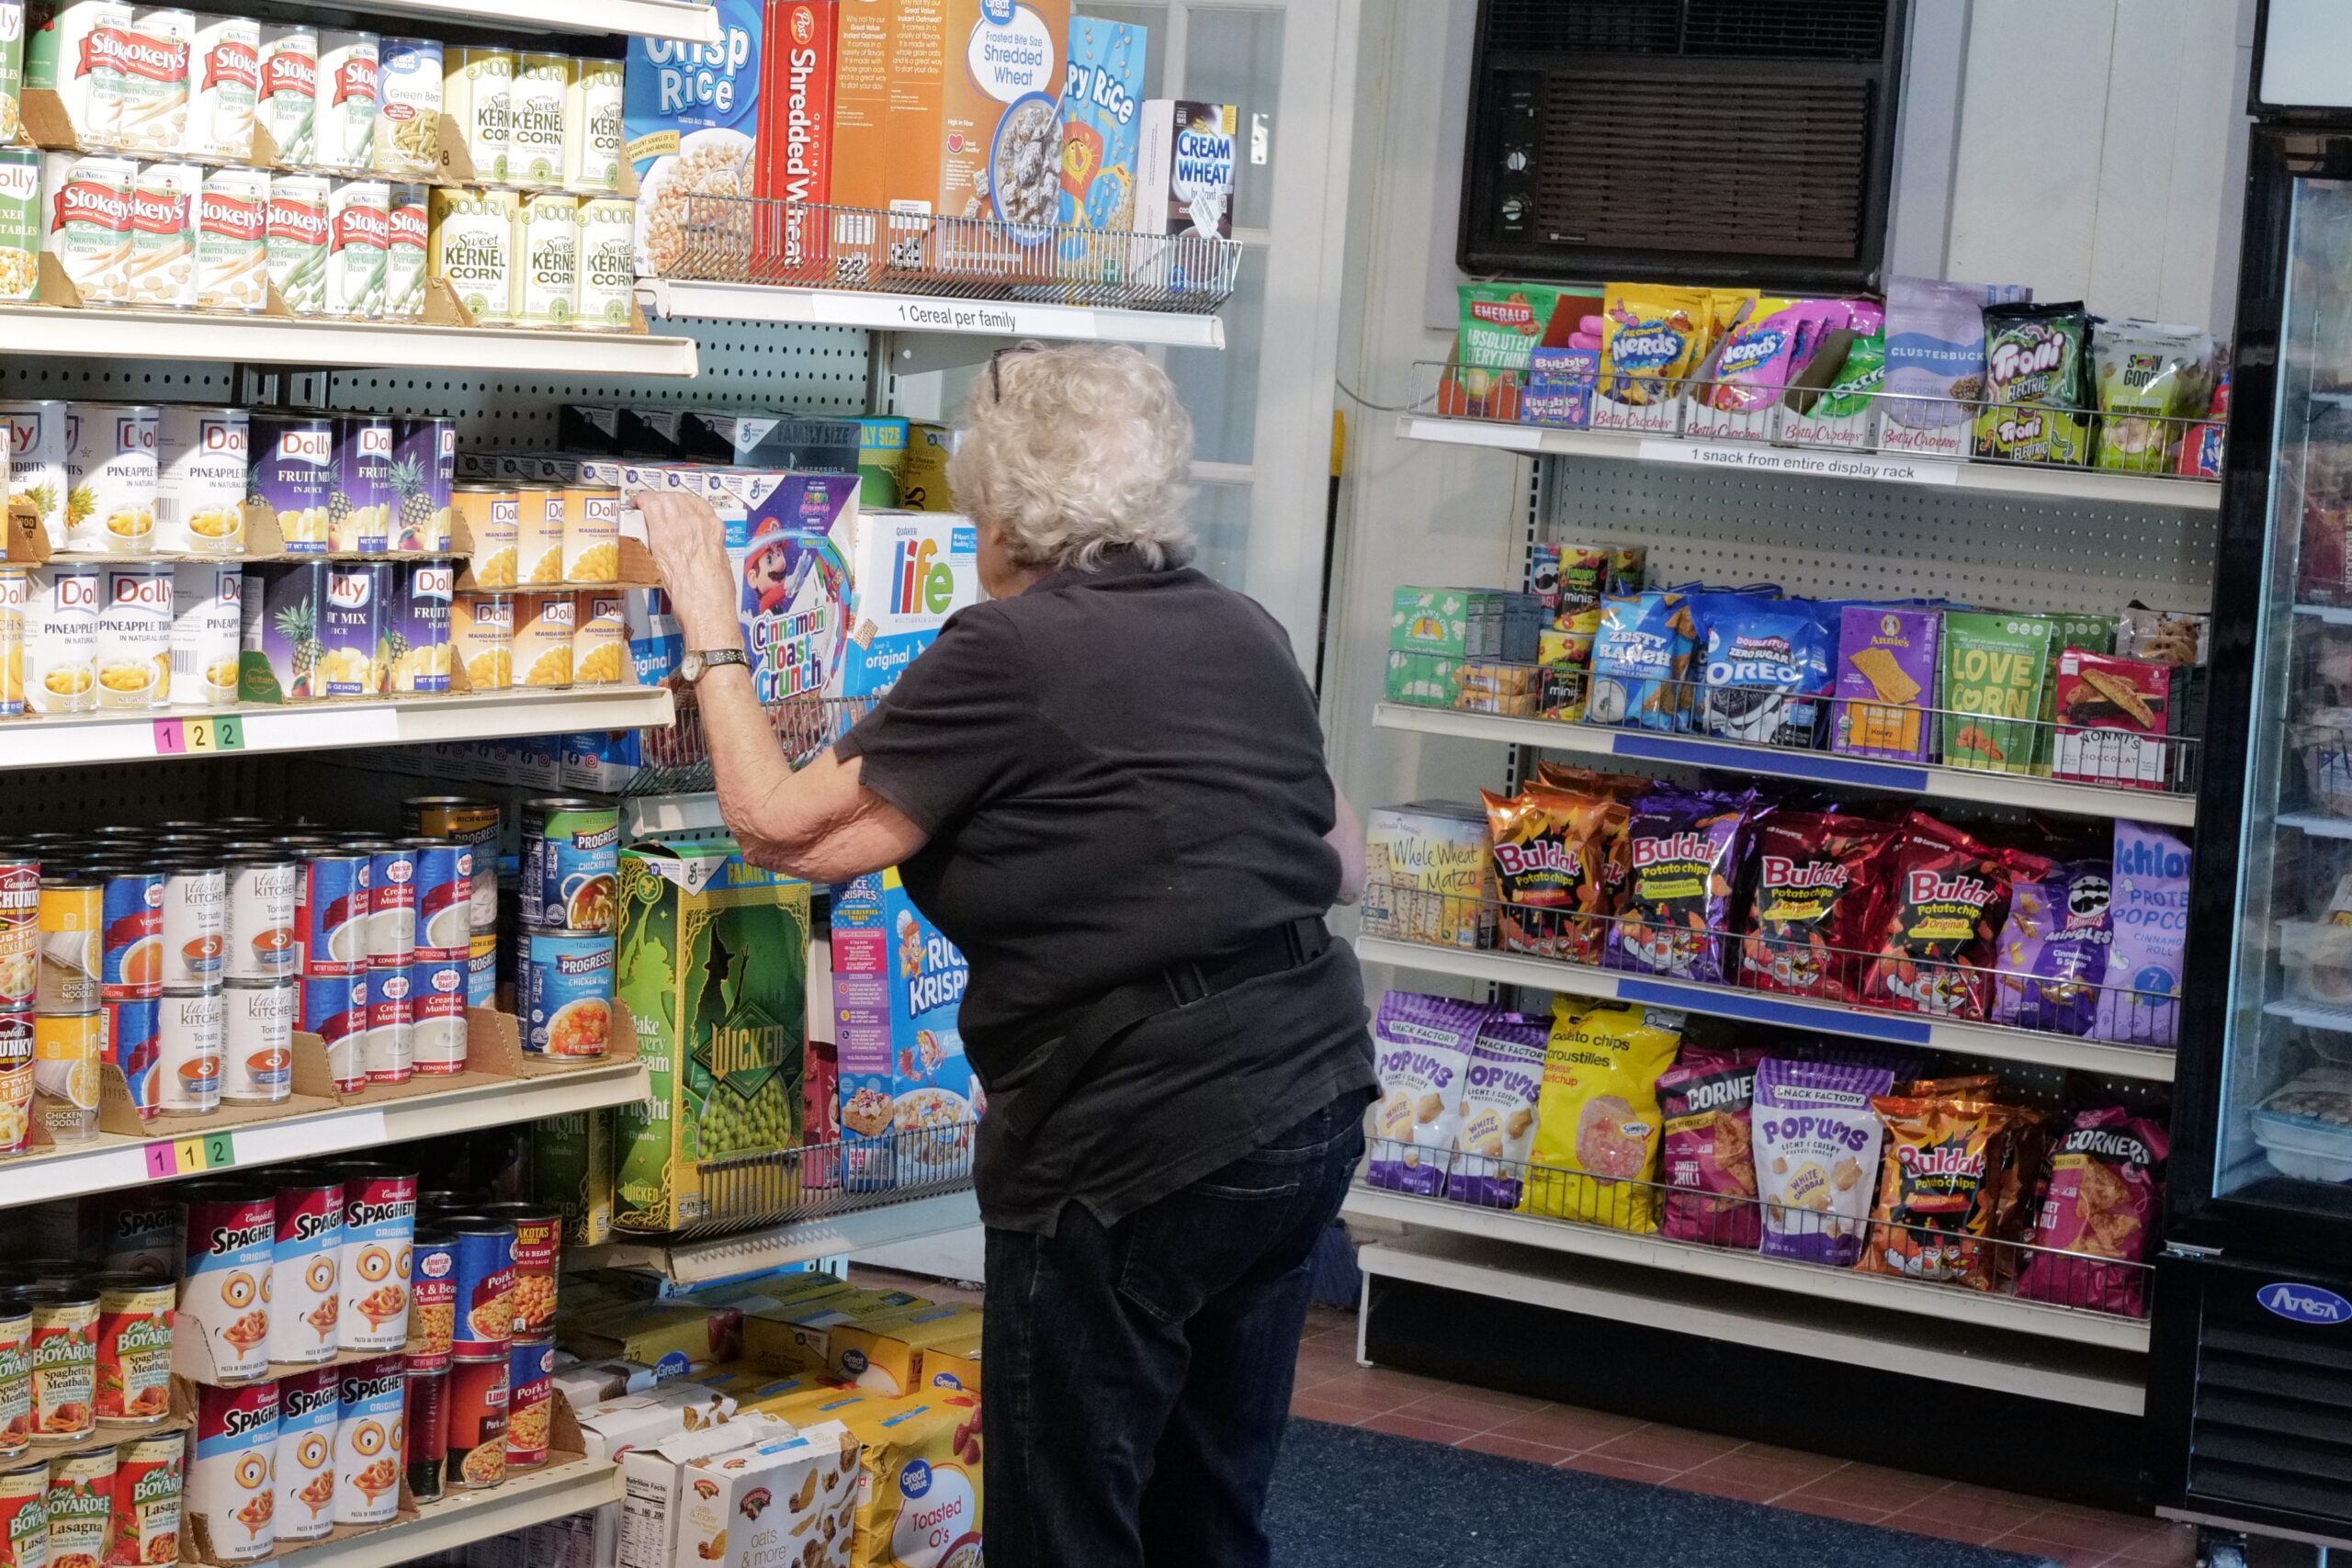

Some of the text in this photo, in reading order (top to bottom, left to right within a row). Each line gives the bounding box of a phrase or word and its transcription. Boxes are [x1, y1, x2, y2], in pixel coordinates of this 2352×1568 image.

[793, 12, 813, 39] Post
[986, 31, 1043, 47] Frosted Bite Size
[387, 51, 415, 63] Great
[984, 45, 1043, 66] Shredded
[994, 66, 1033, 87] Wheat
[660, 66, 736, 112] Rice
[1091, 64, 1135, 126] Rice
[786, 49, 817, 175] Shredded
[512, 113, 564, 132] KERNEL
[517, 132, 562, 145] CORN
[1178, 131, 1230, 160] CREAM
[442, 151, 449, 166] 8
[811, 113, 820, 187] ORIGINAL
[1178, 160, 1230, 186] WHEAT
[457, 233, 498, 250] Sweet
[446, 248, 506, 267] KERNEL
[591, 254, 632, 274] KERNEL
[450, 267, 503, 280] CORN
[595, 274, 632, 287] CORN
[899, 305, 1015, 332] 1 Cereal per family
[1475, 305, 1530, 322] EMERALD
[1467, 329, 1537, 352] ABSOLUTELY
[1534, 357, 1590, 368] Bubble
[1992, 332, 2067, 386] Trolli
[2007, 375, 2050, 403] ELECTRIC
[1525, 397, 1578, 407] Bubble
[1595, 411, 1671, 430] Betty Crocker
[1997, 416, 2043, 443] Trolli
[778, 425, 849, 445] FAMILY SIZE
[879, 426, 900, 446] SIZE
[283, 432, 331, 457] Dolly
[107, 467, 154, 478] PINEAPPLE
[190, 467, 239, 478] PINEAPPLE
[1691, 448, 1915, 479] 1 snack from entire display rack
[278, 470, 315, 483] FRUIT
[897, 527, 917, 536] QUAKER
[890, 538, 954, 615] life
[1565, 592, 1594, 604] minis
[341, 612, 367, 625] MIX
[479, 604, 513, 623] Dolly
[44, 622, 94, 635] PINEAPPLE
[98, 620, 154, 631] PINEAPPLE
[754, 609, 826, 646] Cinnamon
[1609, 631, 1668, 649] ZESTY
[1736, 637, 1763, 649] DOUBLE
[1870, 635, 1910, 648] Annie's
[768, 636, 812, 668] Toast
[866, 651, 910, 671] original
[1728, 647, 1791, 665] ZERO SUGAR
[1706, 660, 1797, 685] OREO
[1952, 649, 2035, 686] LOVE
[756, 660, 824, 704] Crunch
[1550, 686, 1578, 696] minis
[1951, 683, 2030, 720] CORN
[164, 724, 234, 748] 1 2 2
[1871, 728, 1894, 739] Honey
[2079, 731, 2140, 750] NONNI'S
[1394, 837, 1478, 867] Whole Wheat
[1494, 840, 1582, 875] Buldak
[1632, 832, 1720, 868] Buldak
[1642, 863, 1709, 877] Potato chips
[1761, 855, 1849, 888] Buldak
[846, 879, 868, 890] RICE
[1426, 868, 1476, 892] Matzo
[1515, 874, 1574, 887] Potato chips
[384, 888, 406, 897] Cream
[838, 888, 877, 902] KRISPIES
[1771, 888, 1834, 899] Potato chips
[197, 911, 221, 920] Tomato
[266, 905, 291, 913] Tomato
[1917, 904, 1955, 917] Potato
[1928, 919, 1965, 931] Original
[2144, 943, 2174, 958] ROLL
[562, 953, 613, 974] PROGRESSO
[62, 982, 95, 991] CHICKEN
[435, 972, 458, 983] American
[568, 977, 597, 987] CHICKEN
[62, 990, 93, 999] NOODLE
[428, 995, 463, 1007] Cream of
[380, 1002, 404, 1013] Cream
[424, 1002, 463, 1014] Mushroom
[193, 1032, 219, 1042] Tomato
[261, 1024, 288, 1034] Tomato
[1416, 1028, 1457, 1046] FACTORY
[711, 1021, 785, 1081] WICKED
[1592, 1032, 1631, 1052] chips
[1547, 1047, 1611, 1067] croustilles
[1777, 1088, 1863, 1104] SNACK FACTORY
[46, 1111, 83, 1120] CHICKEN
[46, 1118, 81, 1127] NOODLE
[1468, 1116, 1496, 1135] WHITE
[1623, 1123, 1647, 1135] Simple
[1762, 1116, 1870, 1153] POP'UMS
[1781, 1141, 1804, 1152] LIGHT
[154, 1142, 224, 1171] 1 1 2
[1897, 1145, 1987, 1179] Buldak
[1675, 1160, 1699, 1172] SWEET
[1790, 1168, 1819, 1190] WHITE
[1943, 1178, 1976, 1190] chips
[624, 1181, 659, 1203] WICKED
[1792, 1178, 1826, 1201] CHEDDAR
[375, 1227, 410, 1237] ORIGINAL
[531, 1249, 550, 1258] BEANS
[427, 1284, 437, 1294] &
[488, 1271, 511, 1289] Pork
[32, 1344, 96, 1366] BOYARDEE
[44, 1368, 87, 1383] Spaghetti
[46, 1376, 90, 1391] Meatballs
[517, 1383, 540, 1401] Pork
[486, 1420, 500, 1429] Pork
[902, 1469, 928, 1485] Great
[912, 1495, 962, 1533] Toasted
[49, 1522, 103, 1536] Lasagna
[929, 1527, 952, 1549] O's
[751, 1528, 778, 1549] oats
[742, 1543, 786, 1568] & more
